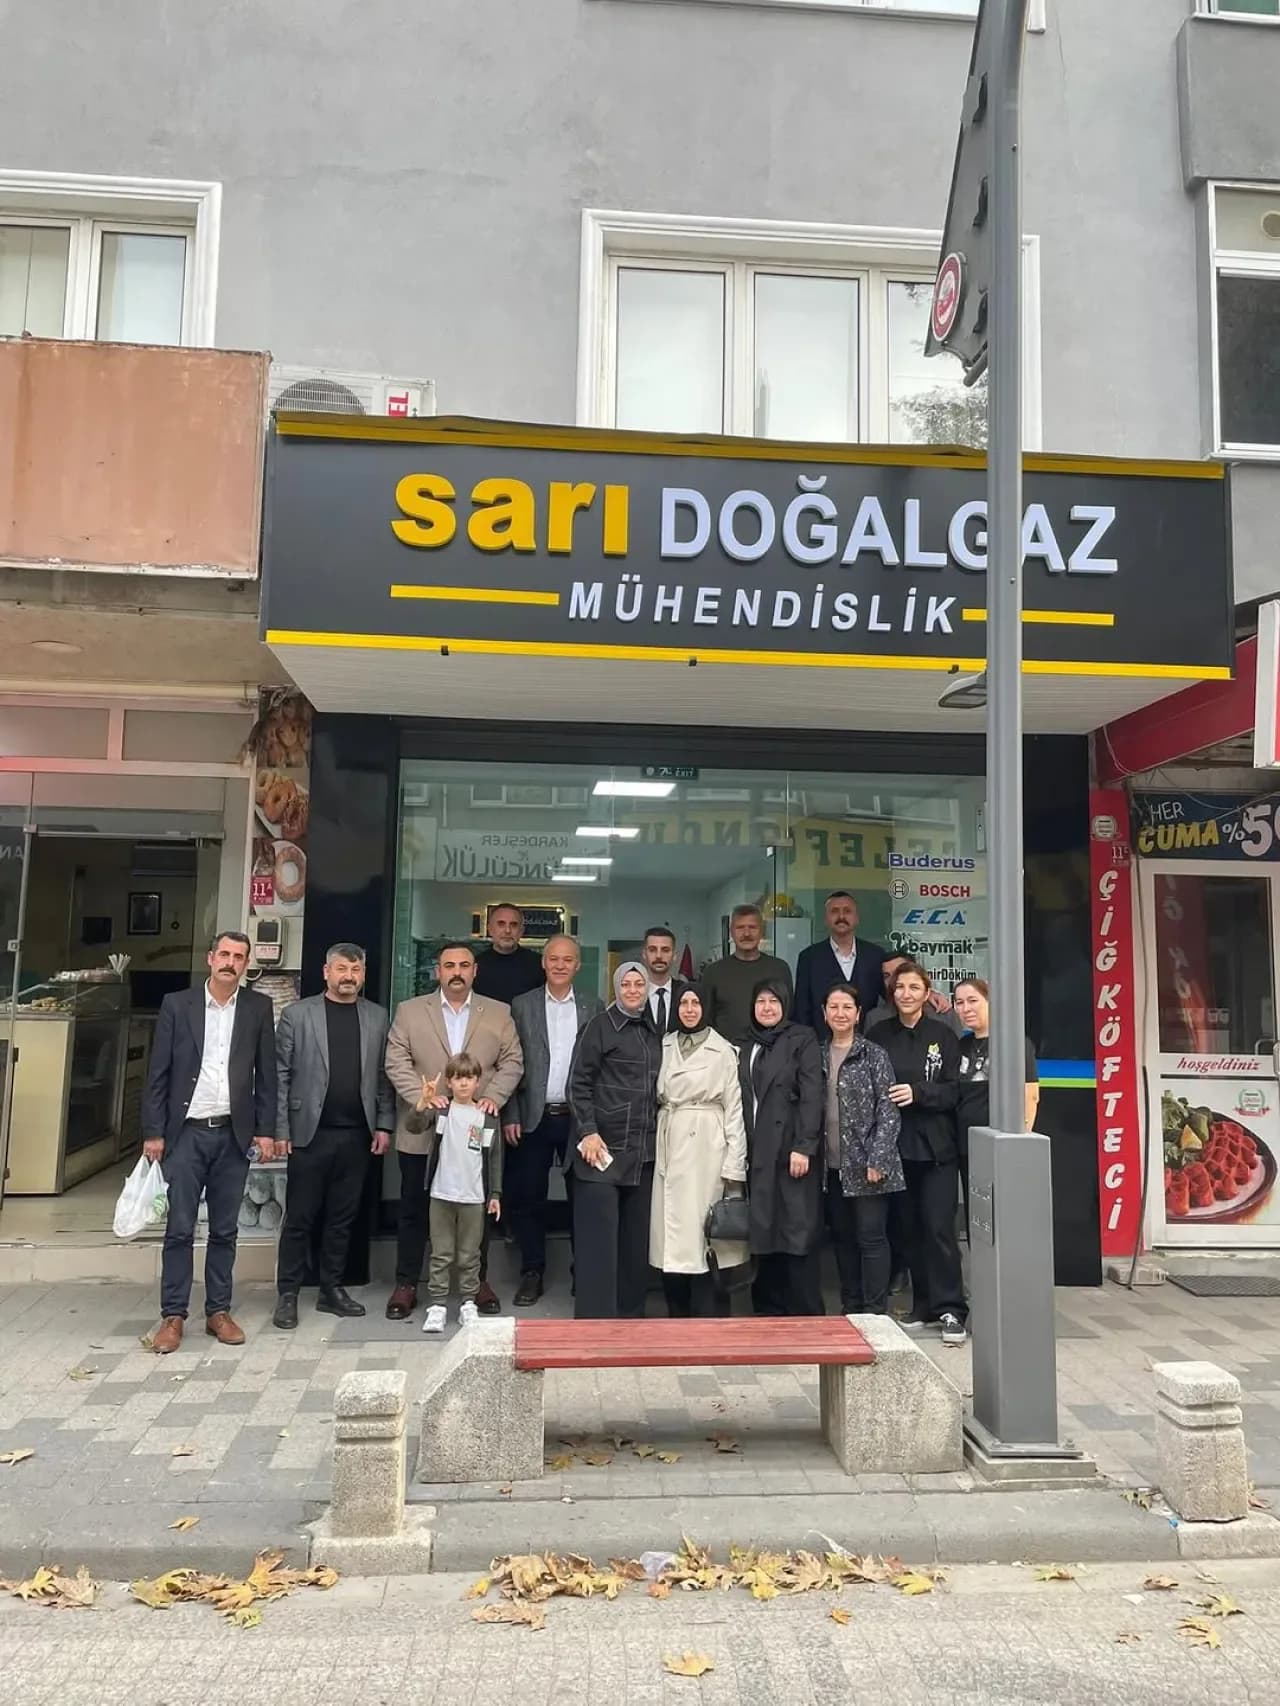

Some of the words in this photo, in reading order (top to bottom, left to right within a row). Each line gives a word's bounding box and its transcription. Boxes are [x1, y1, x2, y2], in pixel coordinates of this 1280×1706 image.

[391, 473, 630, 556] sarı
[660, 476, 1119, 574] DOĞALGAZ
[568, 575, 957, 635] MÜHENDİSLİK
[1150, 802, 1185, 826] HER
[1139, 820, 1220, 853] CUMA
[1222, 804, 1280, 857] %5
[889, 854, 976, 869] Buderus
[919, 885, 971, 898] BOSCH
[909, 938, 974, 956] baymak
[1177, 1057, 1262, 1074] hoşgeldiniz
